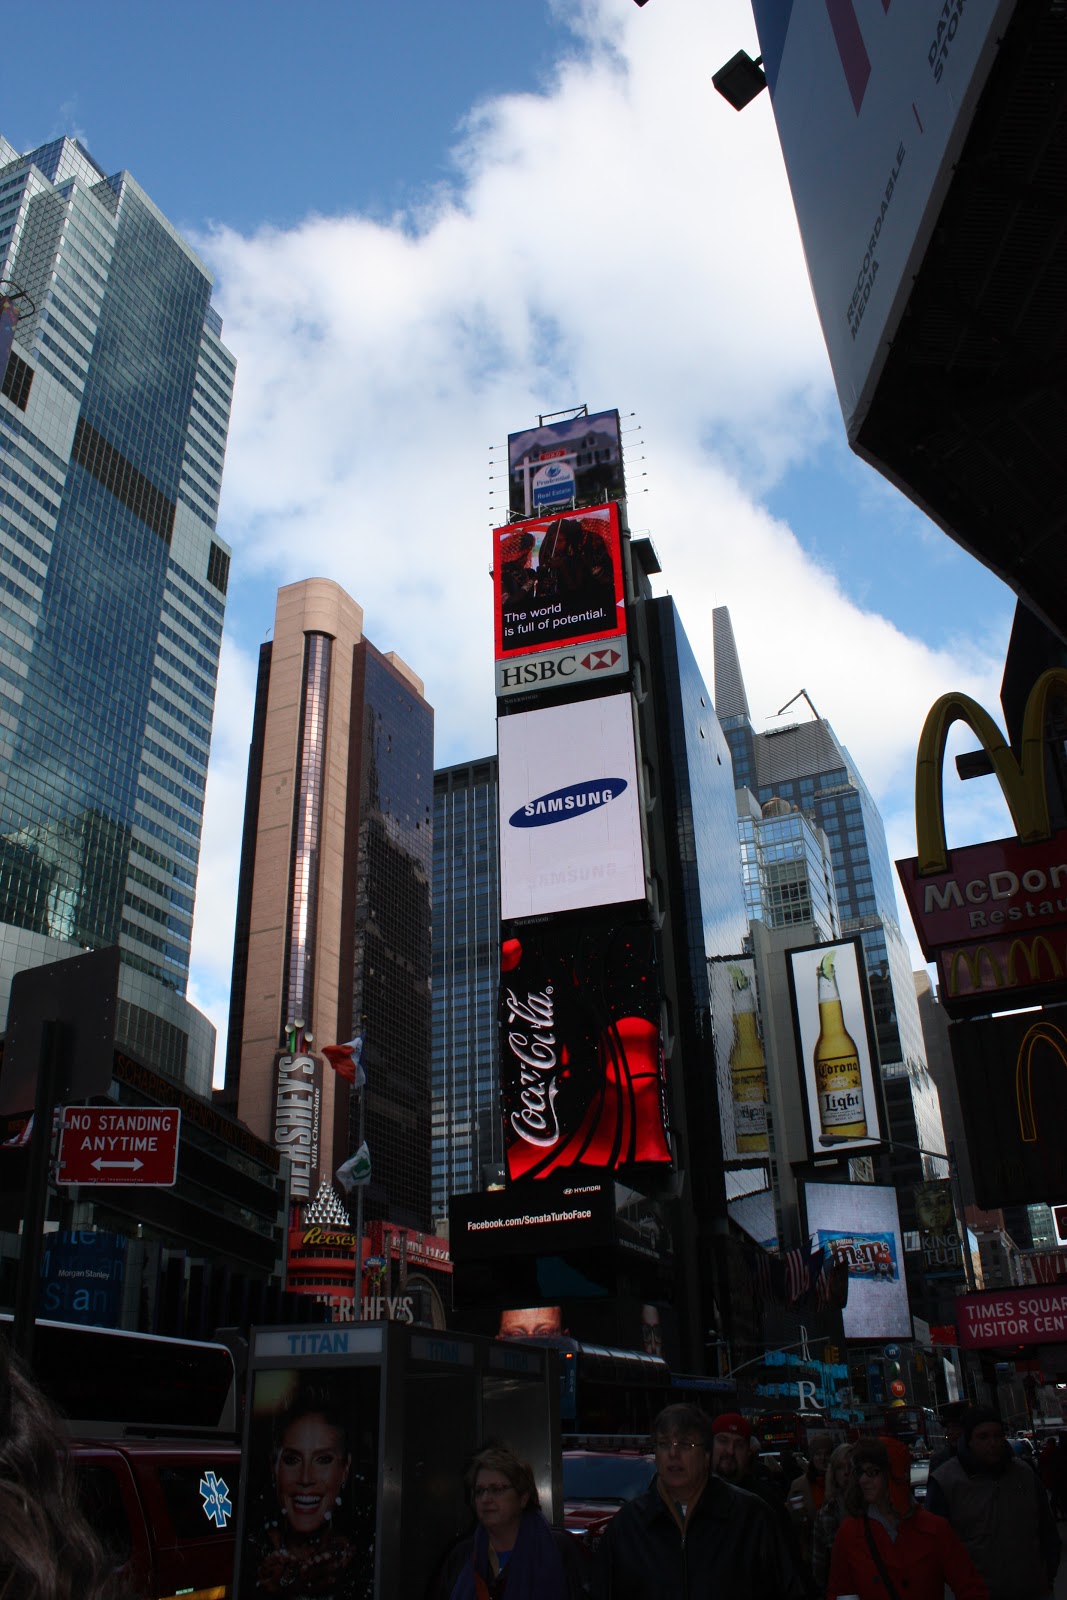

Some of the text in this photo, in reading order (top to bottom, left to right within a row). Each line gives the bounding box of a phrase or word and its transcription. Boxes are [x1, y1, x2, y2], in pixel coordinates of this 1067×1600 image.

[928, 0, 954, 68] DAT
[847, 141, 906, 324] RECORDABLE
[851, 259, 880, 341] MEDIA
[536, 473, 571, 487] Prudential
[537, 487, 572, 500] Real Estate
[504, 603, 562, 623] The world
[504, 608, 607, 637] is full of potential.
[501, 655, 577, 688] HSBC
[524, 789, 613, 817] SAMSUNG
[924, 864, 1067, 913] McDon
[506, 987, 560, 1148] Coca-Cola
[820, 1062, 858, 1078] Corona
[825, 1093, 859, 1112] Light
[70, 1115, 171, 1131] NO STANDING
[312, 1088, 320, 1142] Chocolate
[80, 1136, 158, 1152] ANYTIME
[574, 1185, 601, 1194] HYUNDAI
[467, 1209, 592, 1231] Facebook.com/SonataTurboFace
[303, 1226, 356, 1247] Reese's
[922, 1233, 958, 1250] KING
[924, 1246, 959, 1265] TUT
[58, 1269, 110, 1280] Morgan Stanley
[966, 1301, 1015, 1320] TIMES
[968, 1320, 1029, 1338] VISITOR
[288, 1333, 349, 1354] TITAN
[429, 1341, 459, 1363] TITAN
[796, 1380, 826, 1411] R
